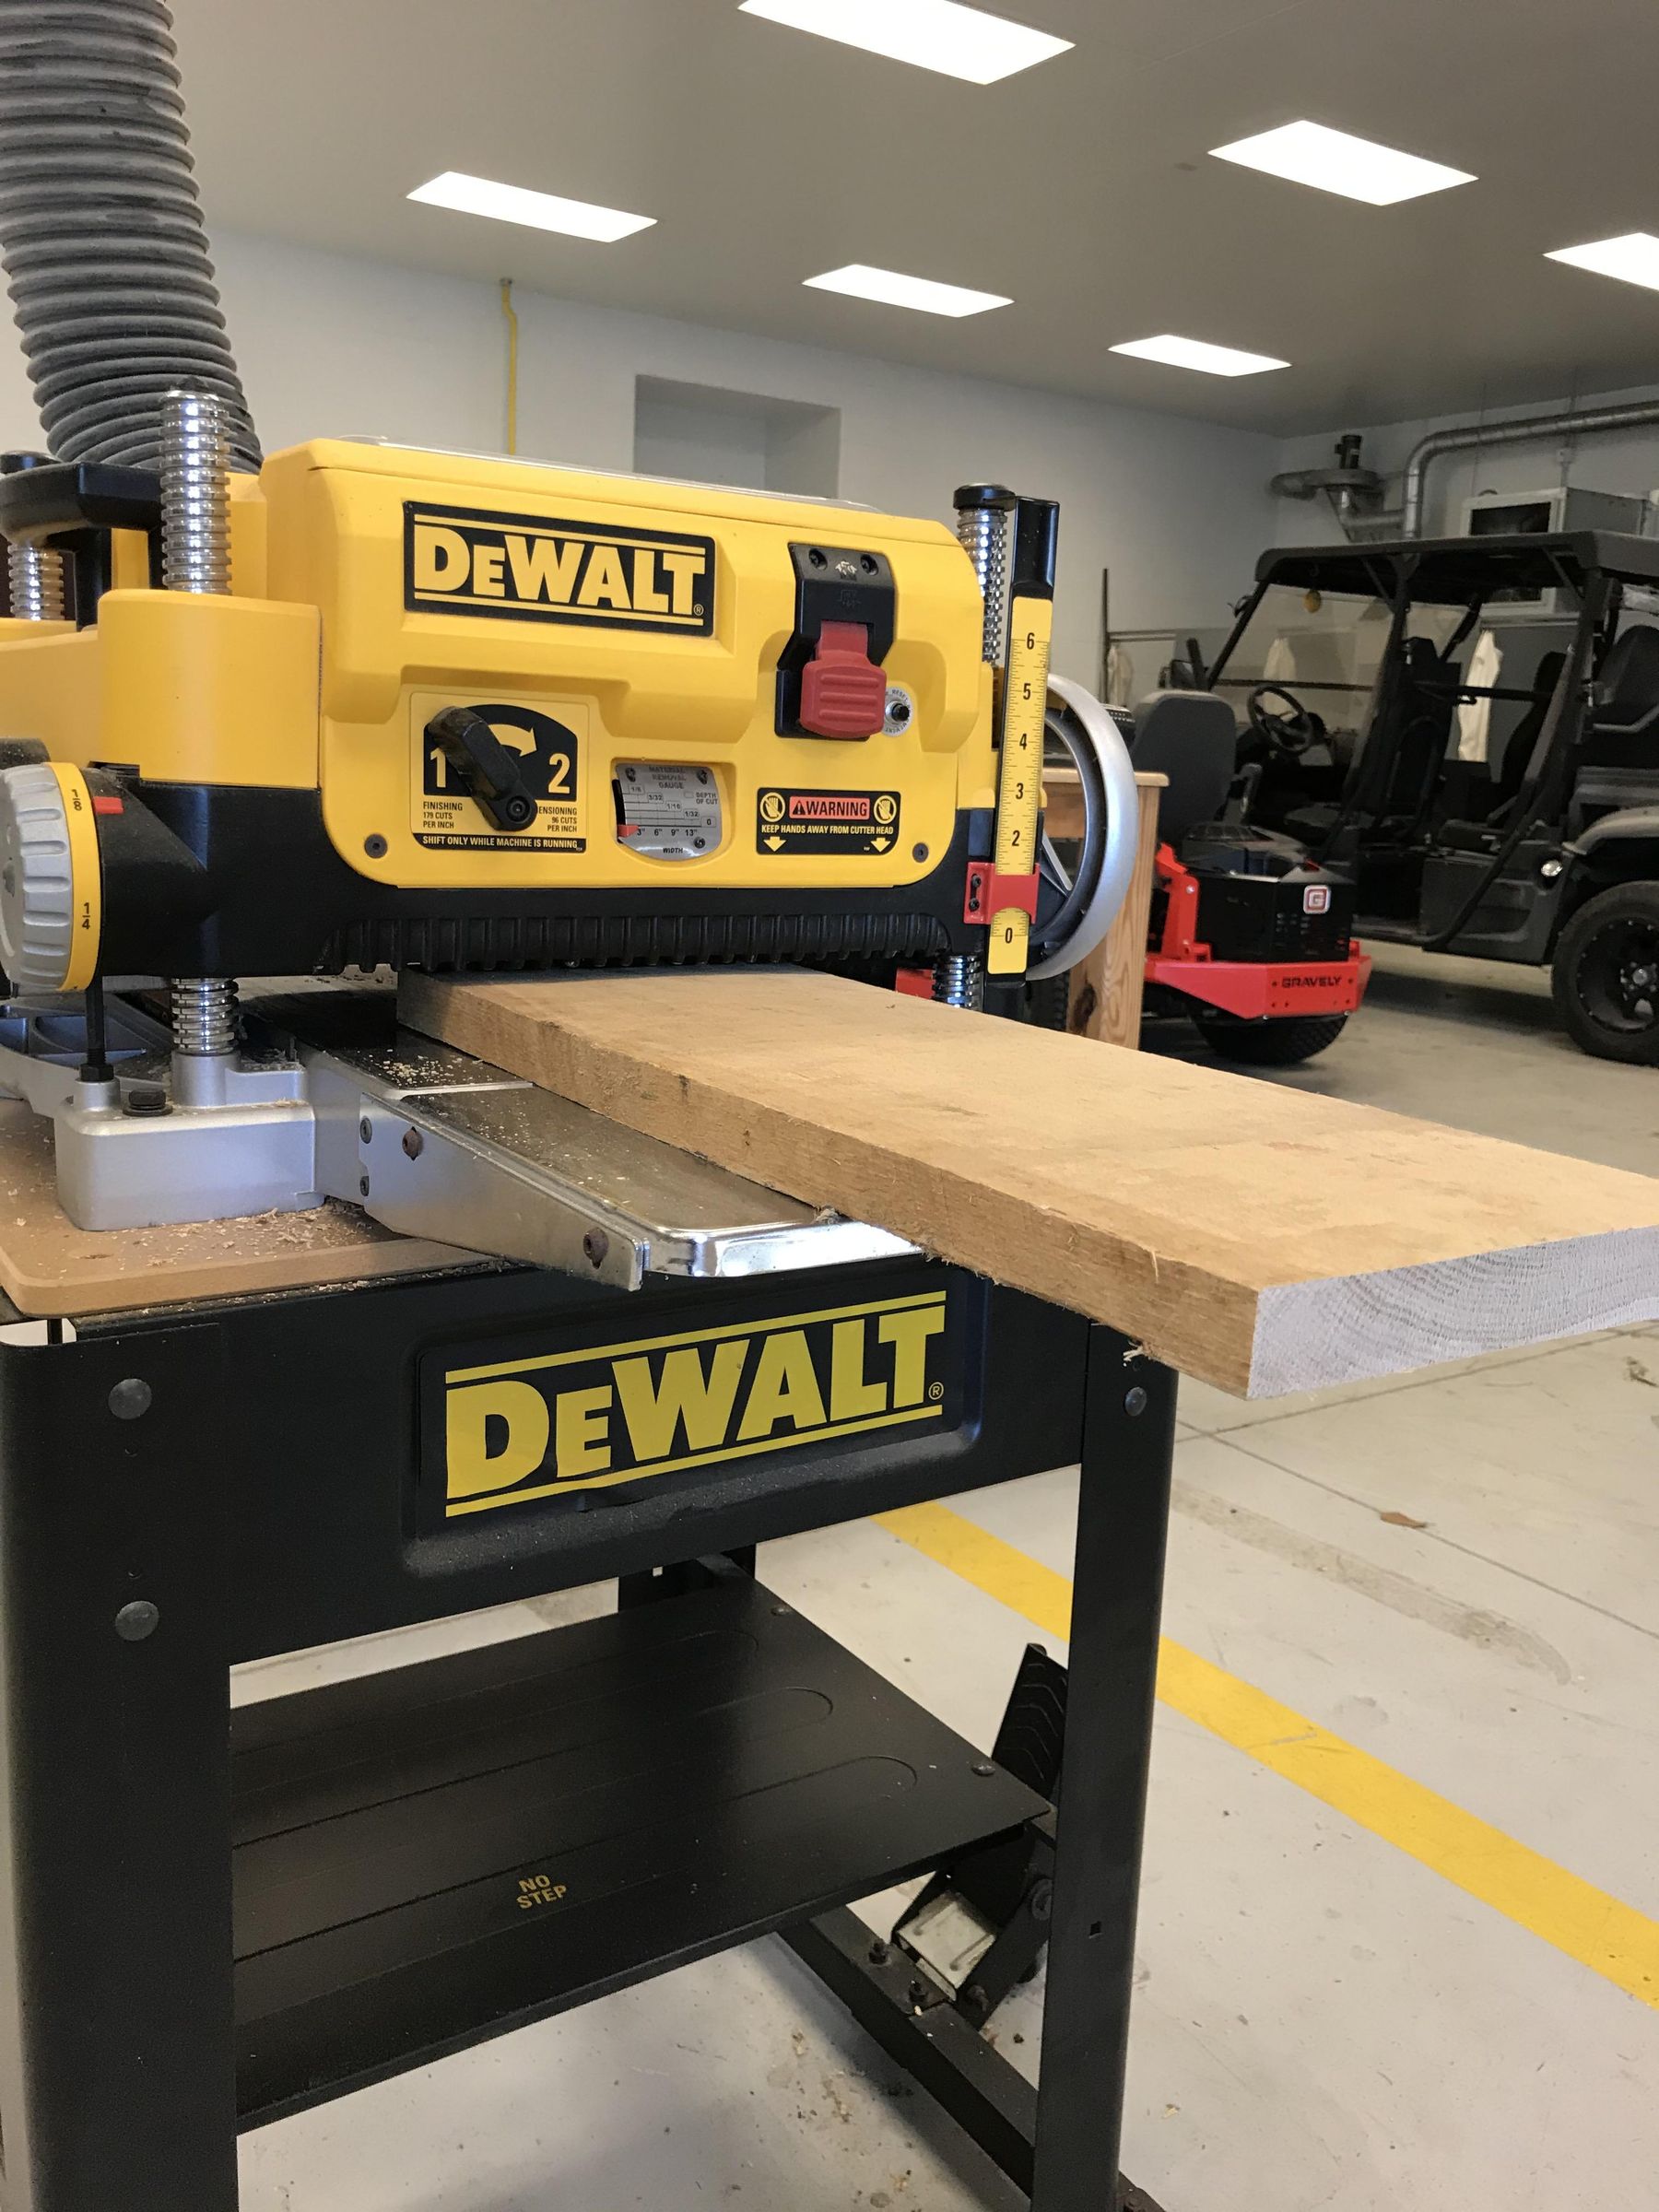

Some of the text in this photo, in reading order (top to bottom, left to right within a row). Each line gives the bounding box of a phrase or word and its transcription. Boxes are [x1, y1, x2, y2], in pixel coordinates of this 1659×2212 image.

[1027, 632, 1035, 650] 6
[1023, 683, 1031, 700] 5
[1019, 734, 1028, 750] 4
[429, 747, 446, 788] 1
[547, 753, 571, 794] 2
[1016, 782, 1024, 799] 3
[423, 801, 463, 811] FINISHING
[538, 806, 577, 816] ENSIONING
[806, 801, 867, 817] WARNING
[435, 812, 453, 820] CUTS
[559, 817, 577, 825] CUTS
[561, 825, 577, 833] INCH
[686, 829, 698, 837] 13"
[761, 824, 894, 835] KEEP HANDS AWAY FROM CUTTER HEAD
[422, 835, 577, 849] SHIFT ONLY WHILE MACHINE IS RUNNING
[1012, 830, 1020, 847] 2
[1006, 927, 1013, 944] 0
[1281, 976, 1342, 988] GRAVELY
[518, 1875, 551, 1893] NO
[516, 1885, 568, 1910] STEP
